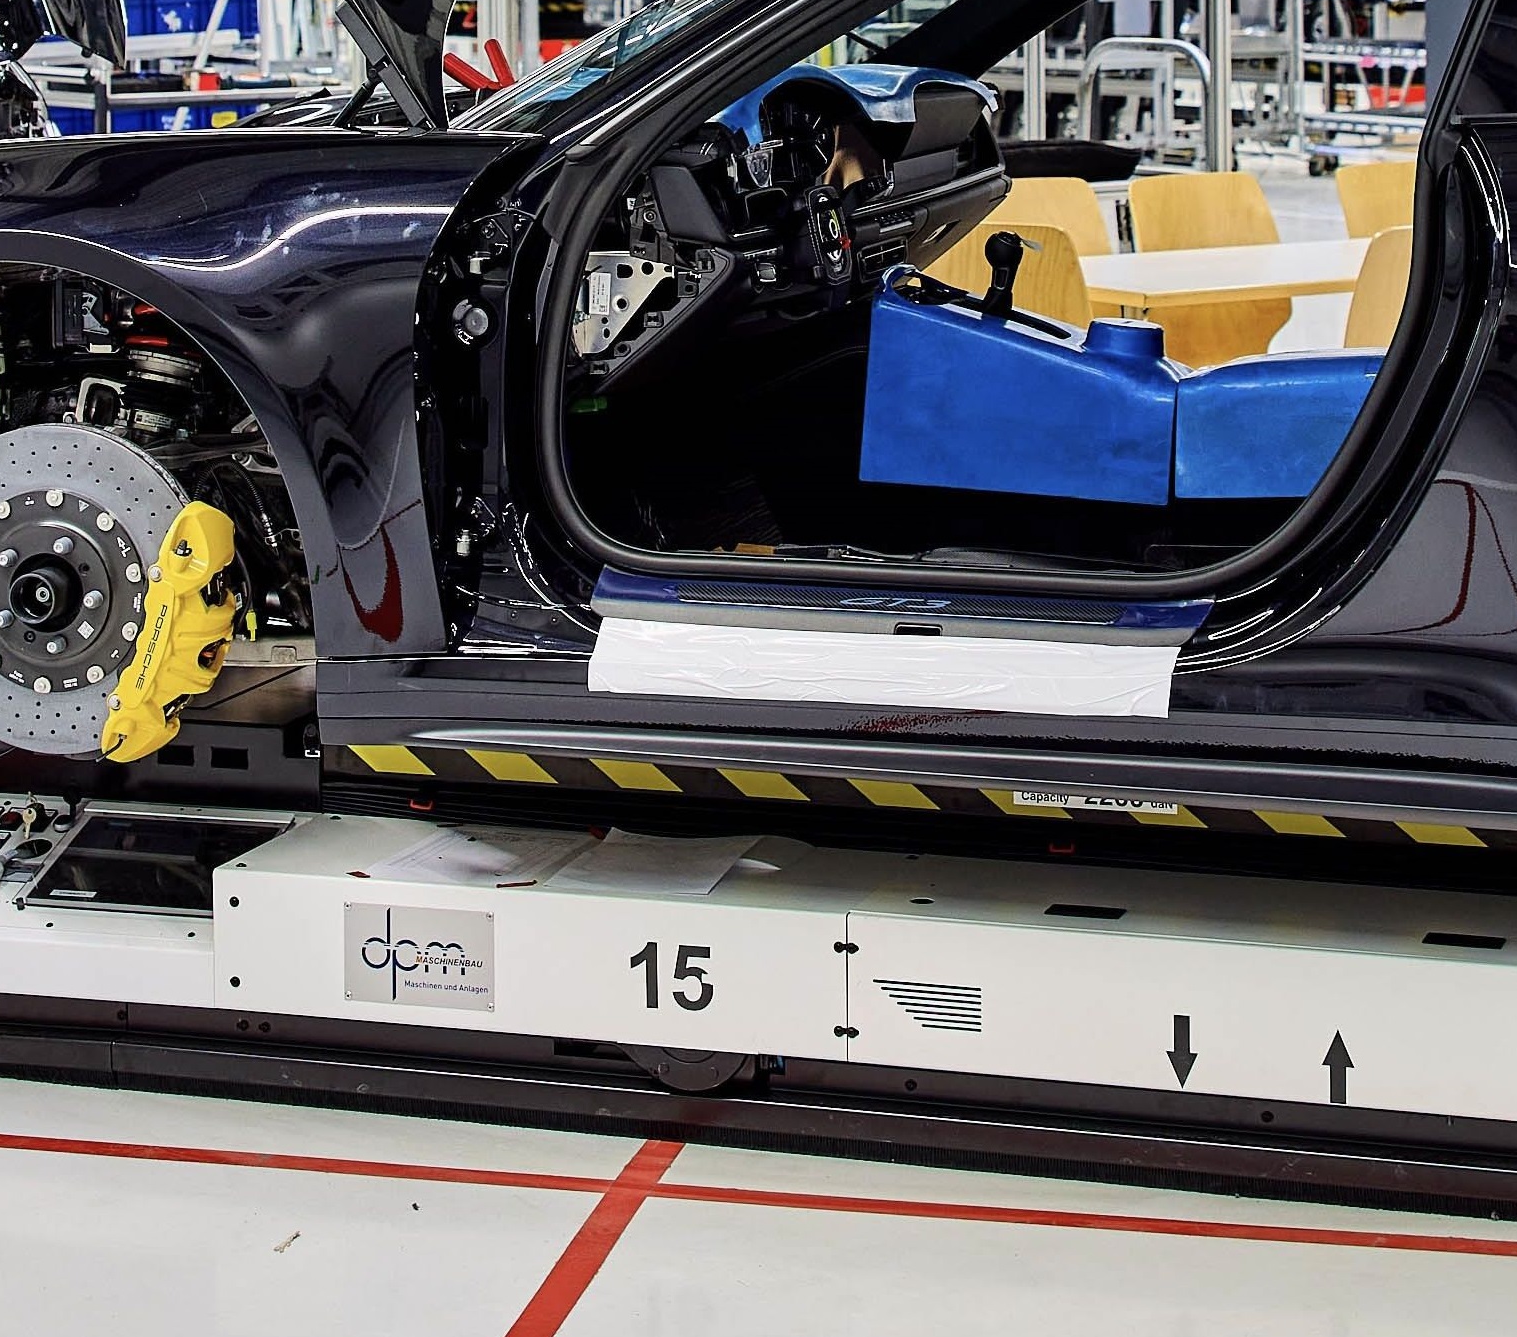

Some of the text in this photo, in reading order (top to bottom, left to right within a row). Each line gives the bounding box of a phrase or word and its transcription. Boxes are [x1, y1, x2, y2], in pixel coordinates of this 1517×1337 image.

[840, 597, 951, 609] GT3
[136, 604, 168, 690] PORSCHE
[1021, 791, 1070, 805] Capacity
[361, 907, 465, 1001] dpm
[415, 955, 483, 968] MASCHINENBAU
[630, 941, 714, 1011] 15
[404, 980, 488, 995] Maschinen und Anlagen
